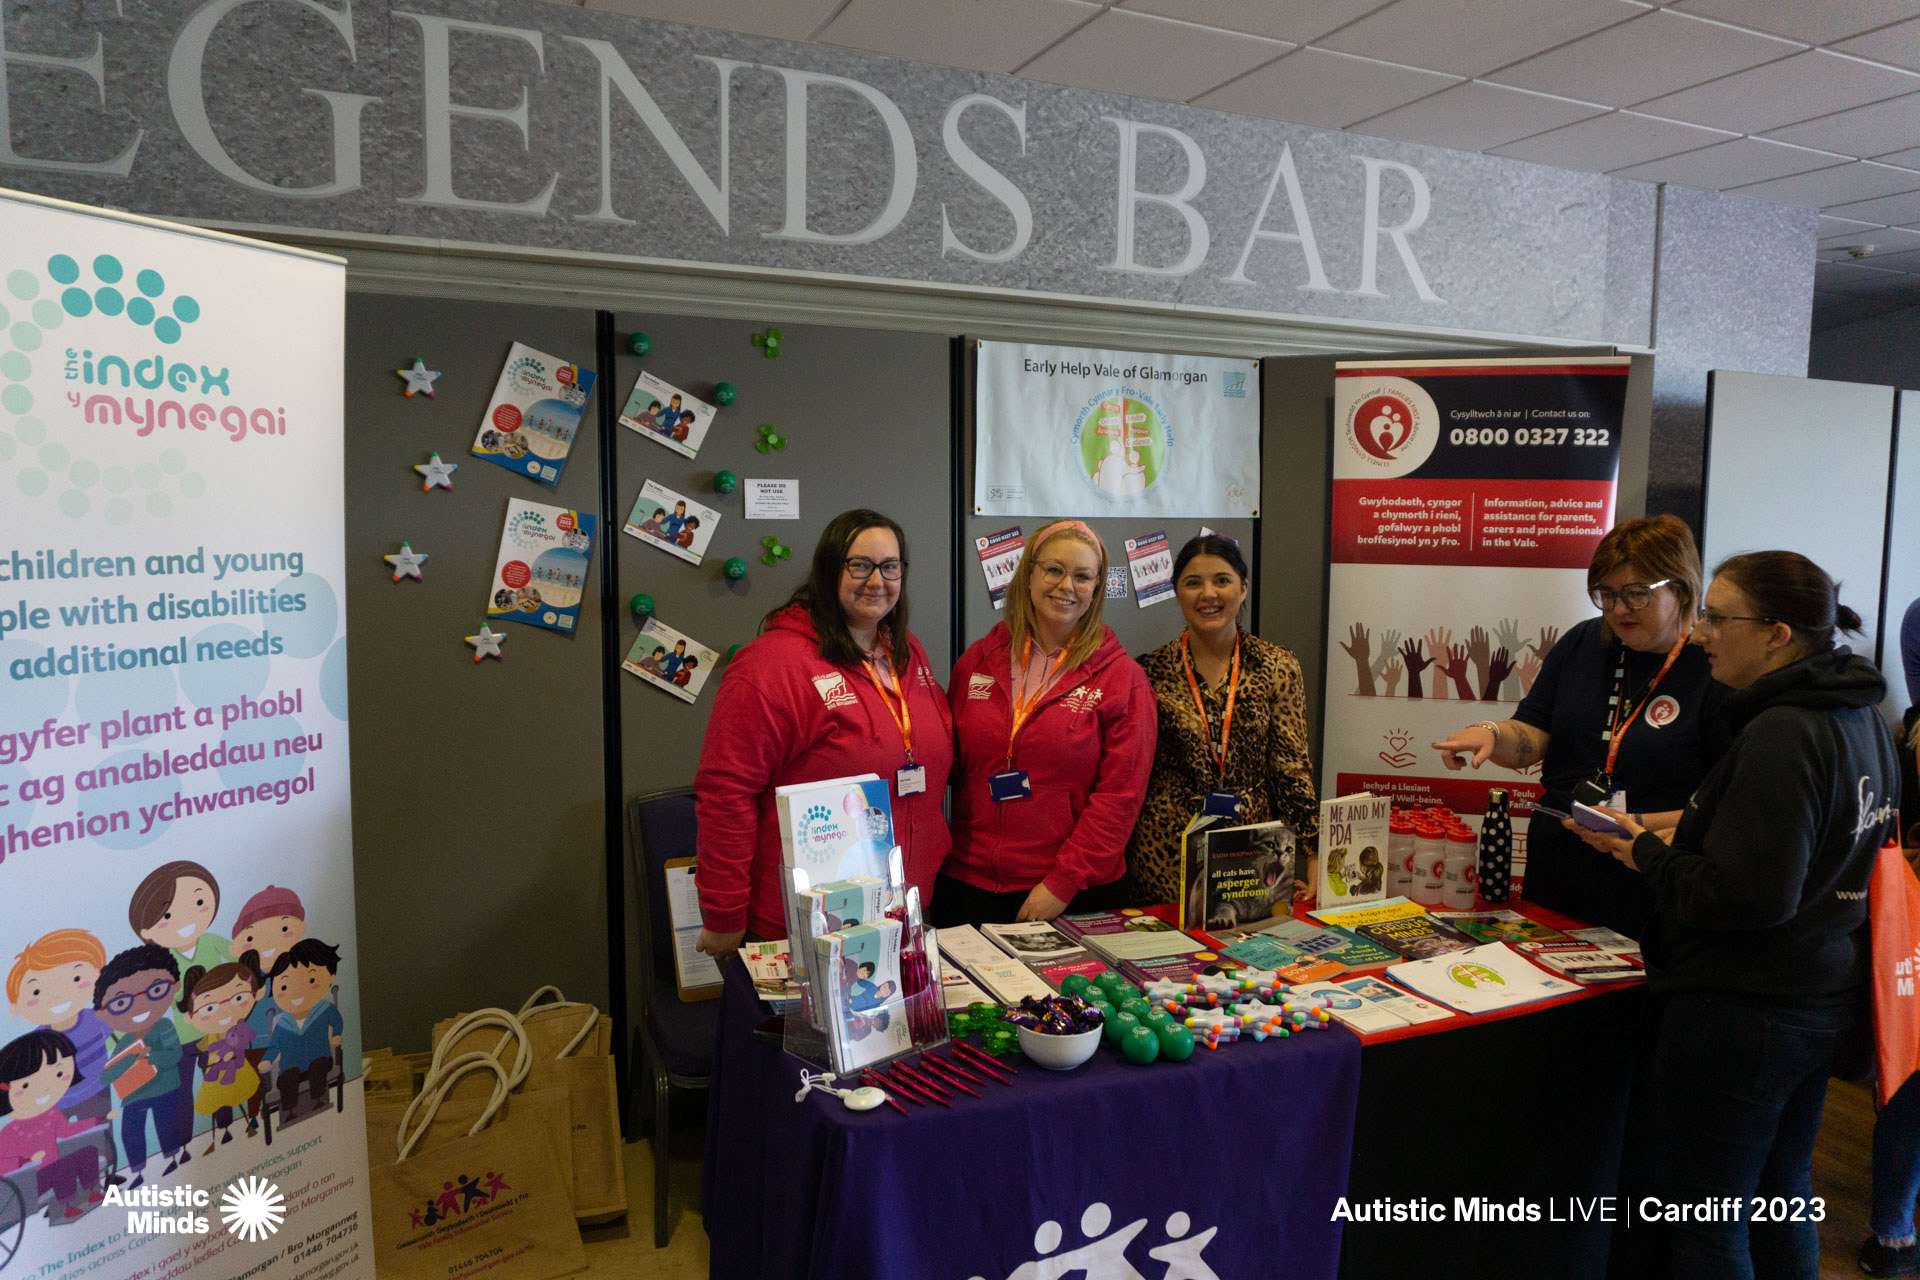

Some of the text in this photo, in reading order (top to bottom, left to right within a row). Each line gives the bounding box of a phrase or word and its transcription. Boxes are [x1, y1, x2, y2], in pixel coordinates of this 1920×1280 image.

[1098, 116, 1448, 301] BAR
[83, 350, 230, 396] index
[1024, 359, 1208, 385] Early Help Vale of Glamorgan
[85, 394, 286, 442] mynegai
[1451, 409, 1495, 419] Cysylltwch
[1504, 410, 1512, 418] ni
[1532, 409, 1566, 418] Contact
[1450, 428, 1610, 446] 0800 0327 322
[1359, 497, 1462, 508] Gwybodaeth, cyngor
[1484, 498, 1603, 509] Information, advice and
[1373, 511, 1379, 519] a
[1381, 510, 1428, 521] chymorth
[1435, 510, 1461, 521] rieni,
[1483, 512, 1597, 524] assistance for parents,
[1378, 523, 1461, 534] gofalwyr a phobl
[1483, 525, 1604, 537] carers and professionals
[1357, 535, 1460, 547] broffesiynol yn y Fro.
[1482, 538, 1539, 547] in the Vale.
[145, 546, 205, 576] and
[213, 551, 303, 581] young
[59, 595, 137, 627] with
[147, 588, 307, 621] disabilities
[10, 630, 284, 680] additional needs
[101, 706, 187, 749] plant
[194, 706, 214, 727] a
[222, 688, 302, 731] phobl
[18, 732, 323, 805] ag anableddau neu
[1363, 781, 1390, 792] Iechyd
[1398, 783, 1431, 793] Llesiant
[1511, 789, 1536, 798] Teulu
[138, 767, 315, 835] ychwanegol
[1330, 800, 1387, 823] ME AND MY
[1329, 823, 1352, 847] PDA
[1211, 868, 1256, 879] all cats have
[1216, 877, 1261, 891] asperger
[1221, 888, 1270, 902] syndrome
[1370, 919, 1431, 935] CURIOUS
[1387, 927, 1435, 940] MINDS
[246, 1154, 285, 1178] services,
[287, 1135, 322, 1158] support
[301, 1175, 354, 1208] Morgannwg
[287, 1210, 358, 1256] Bro Morgannwg
[293, 1243, 323, 1265] 01446
[326, 1222, 359, 1247] 704736
[39, 1259, 64, 1276] The
[68, 1241, 105, 1262] Index
[448, 1259, 473, 1274] 01446
